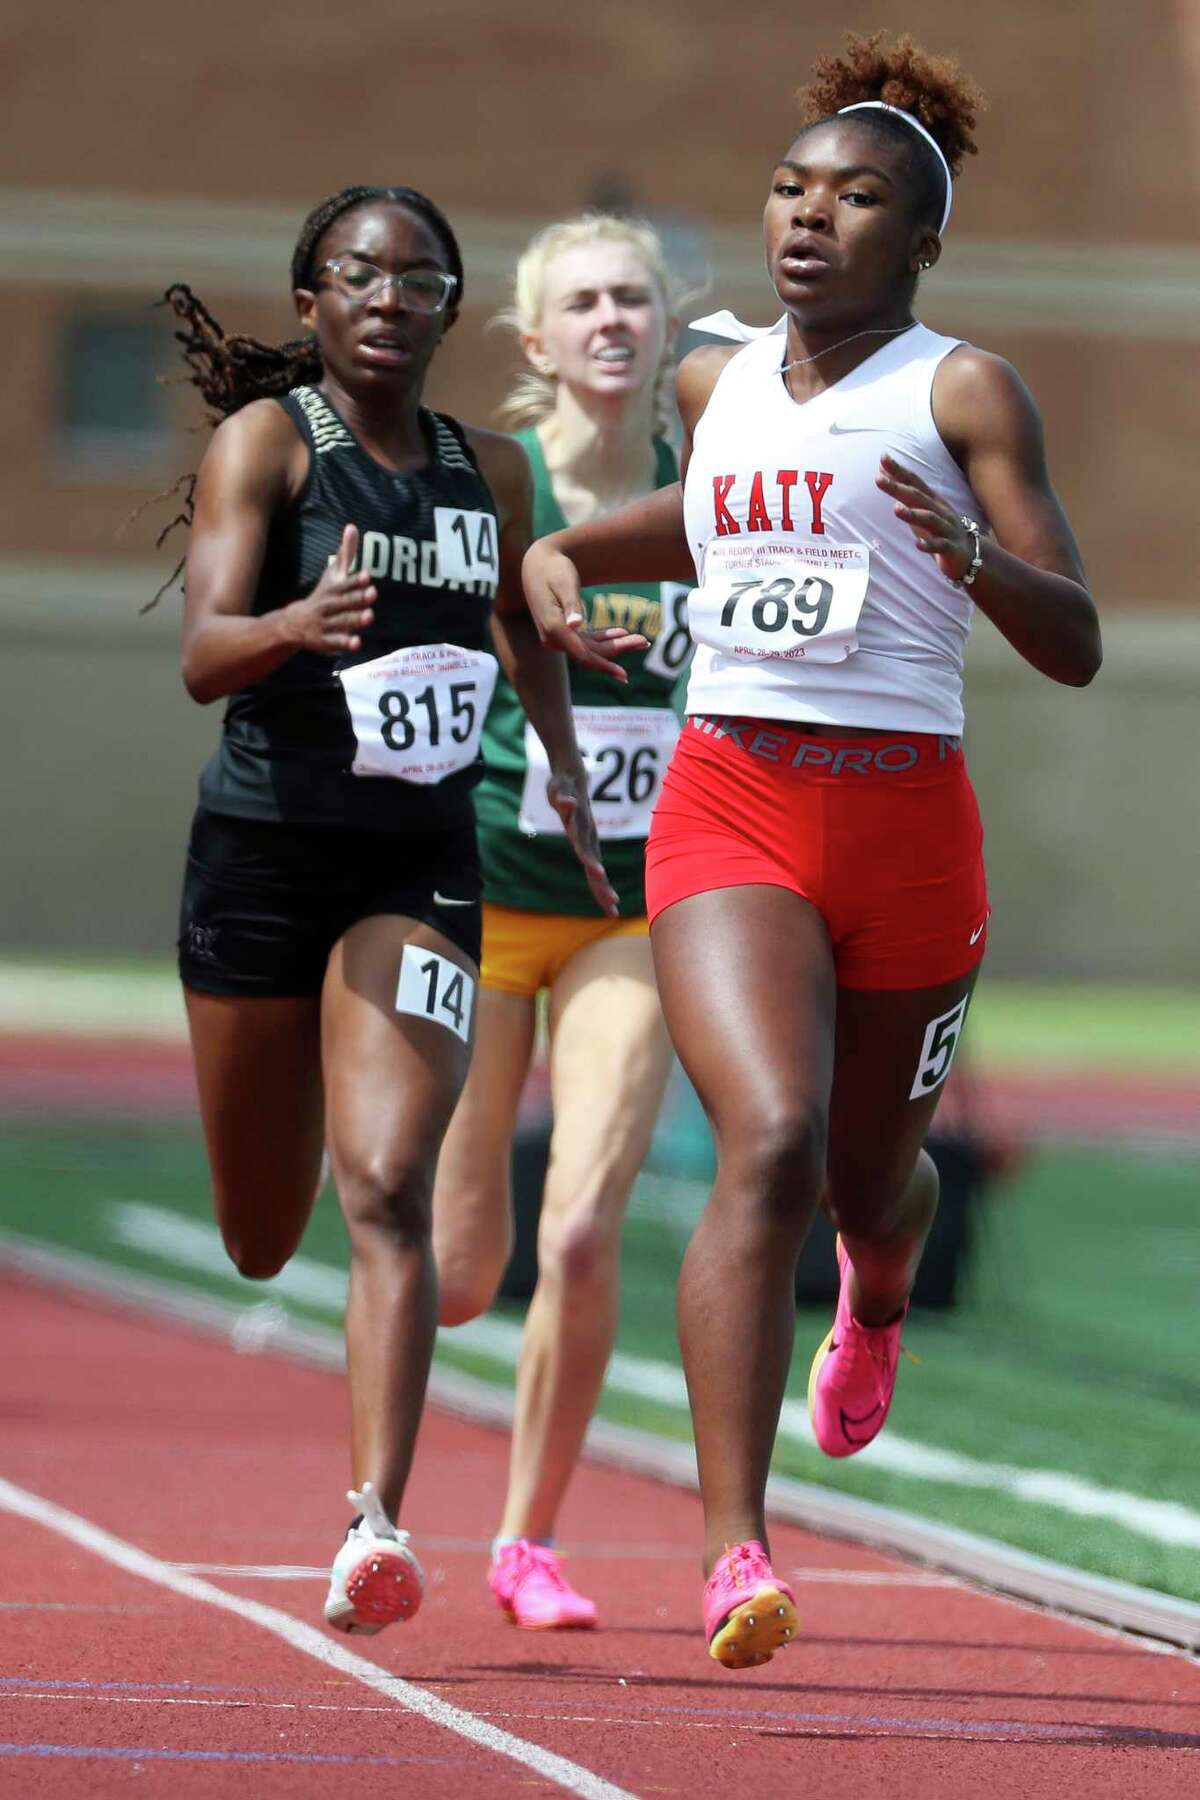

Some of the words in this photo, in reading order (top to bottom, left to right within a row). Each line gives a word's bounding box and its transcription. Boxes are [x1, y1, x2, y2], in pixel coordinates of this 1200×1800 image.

[712, 470, 833, 536] KATY
[451, 514, 495, 571] 14
[767, 545, 793, 555] TRACK
[805, 549, 828, 558] FIELD
[830, 550, 853, 559] MEET
[720, 577, 833, 636] 789
[734, 645, 756, 656] APRIL
[784, 648, 805, 658] 2023
[378, 681, 476, 751] 815
[578, 747, 657, 802] 26
[792, 743, 919, 774] PRO
[421, 959, 464, 1030] 14
[922, 1007, 962, 1087] 5
